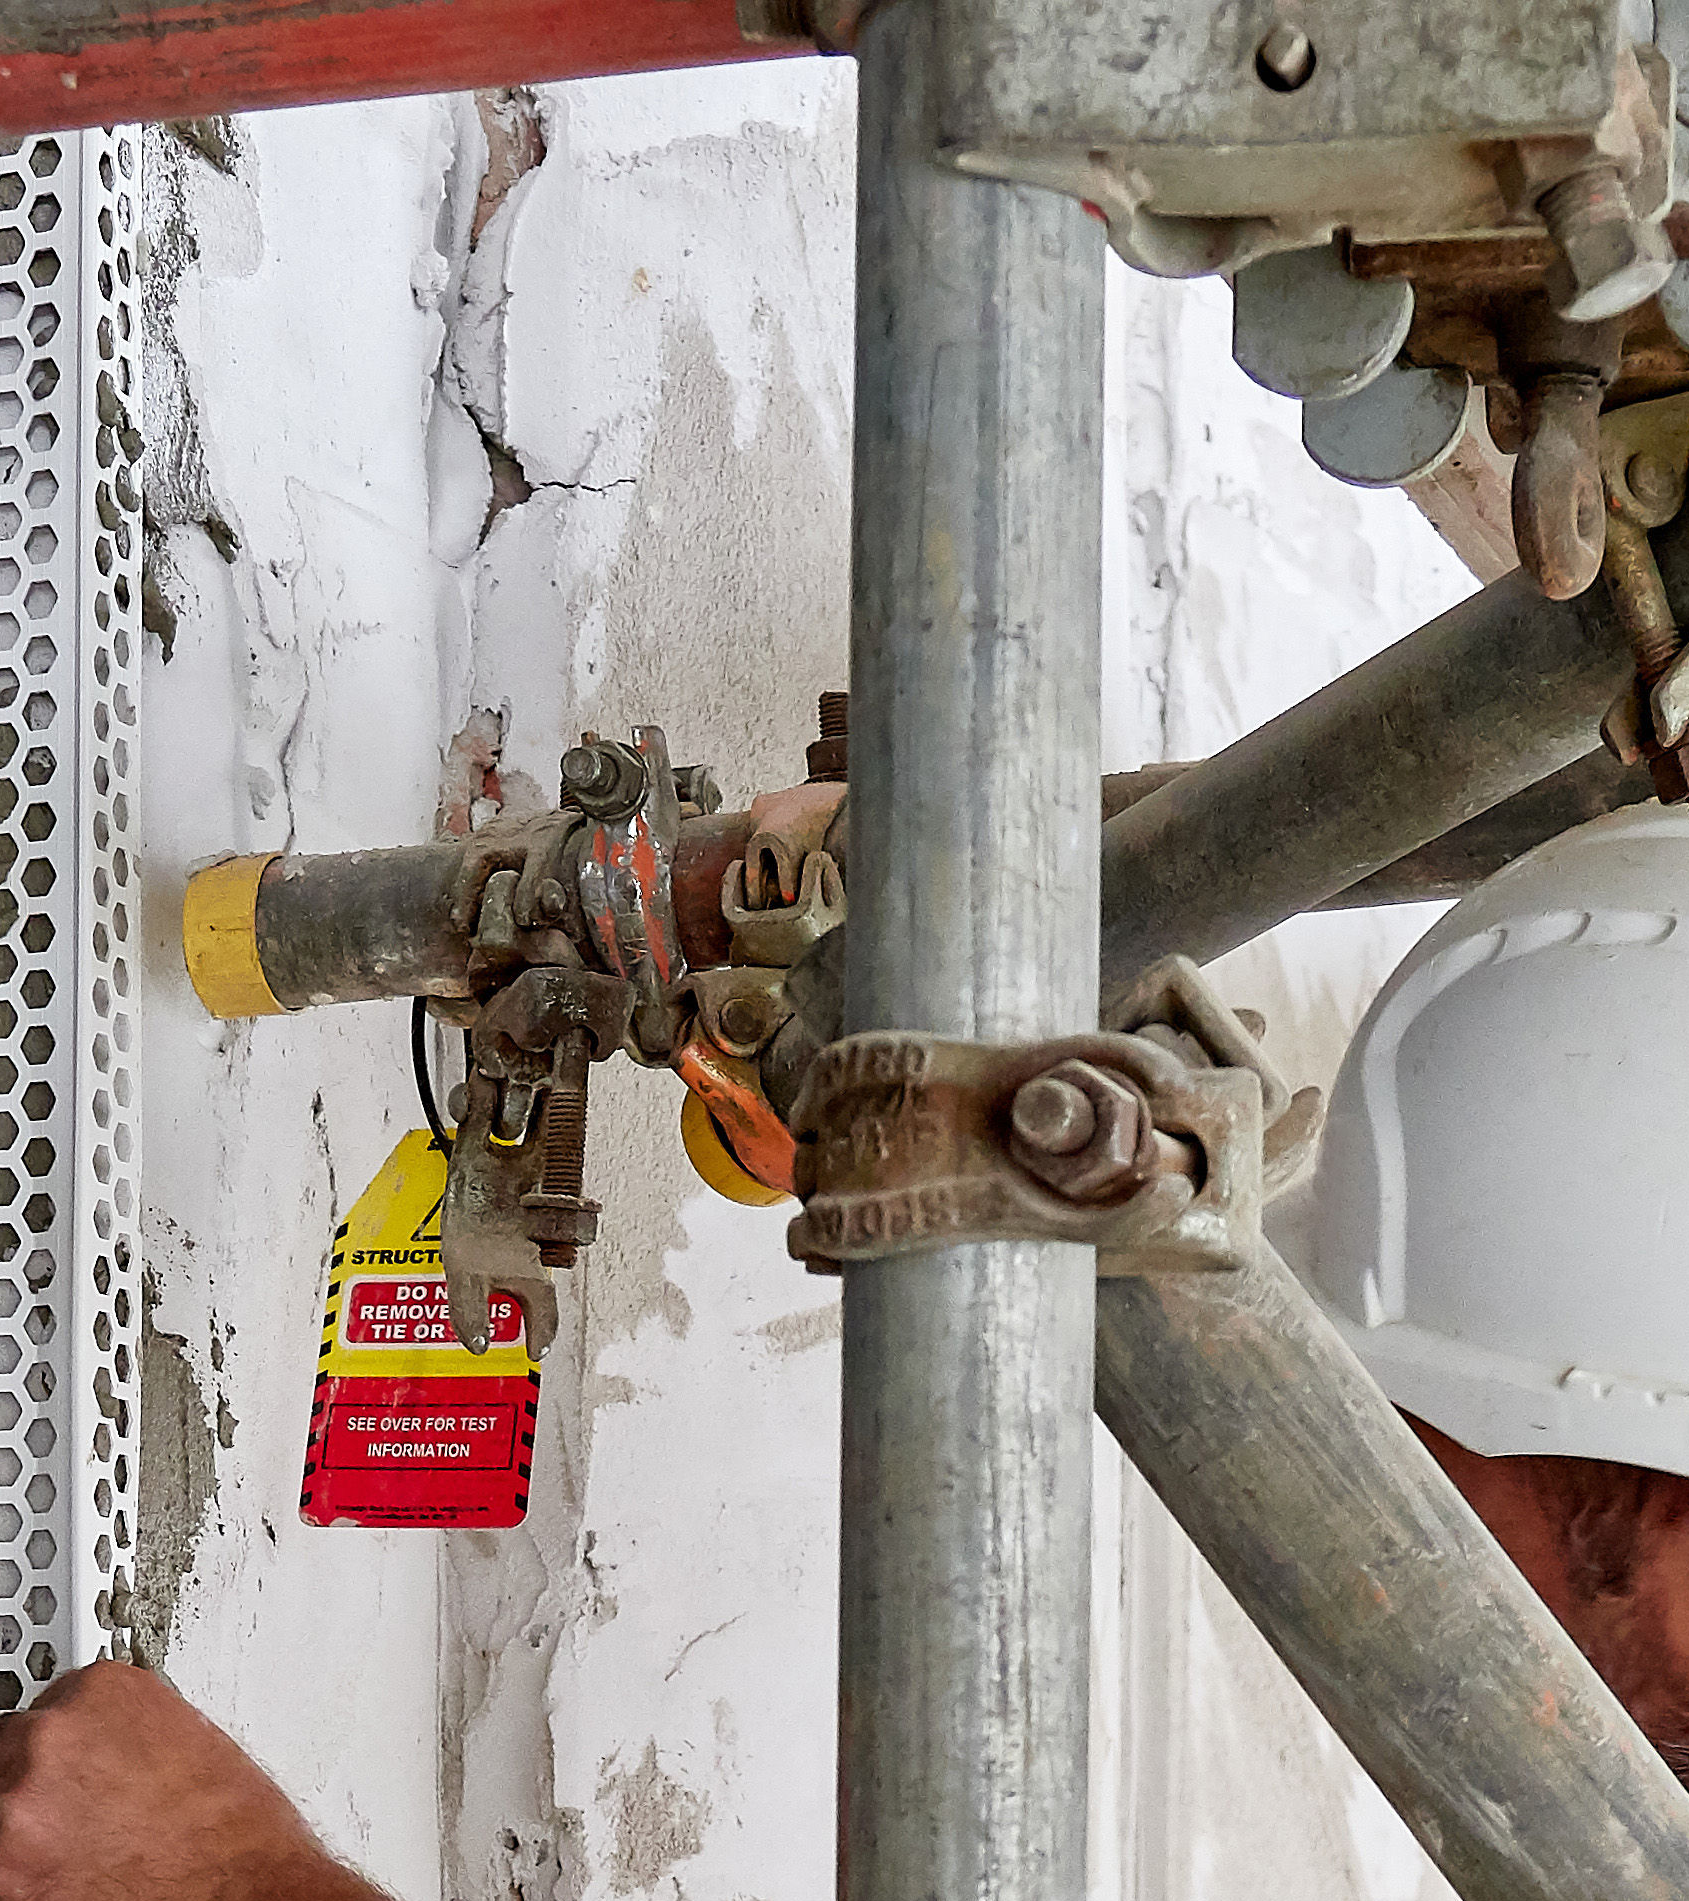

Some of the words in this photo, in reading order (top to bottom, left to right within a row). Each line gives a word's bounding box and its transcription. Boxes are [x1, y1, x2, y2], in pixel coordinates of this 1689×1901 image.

[396, 1285, 428, 1301] DO
[360, 1304, 450, 1320] REMOVE
[490, 1303, 512, 1319] IS
[371, 1323, 407, 1339] TIE
[413, 1323, 445, 1339] OR
[347, 1416, 377, 1431] SEE
[380, 1416, 421, 1432] OVER
[425, 1416, 456, 1431] FOR
[460, 1416, 498, 1432] TEST
[367, 1443, 470, 1458] INFORMATION
